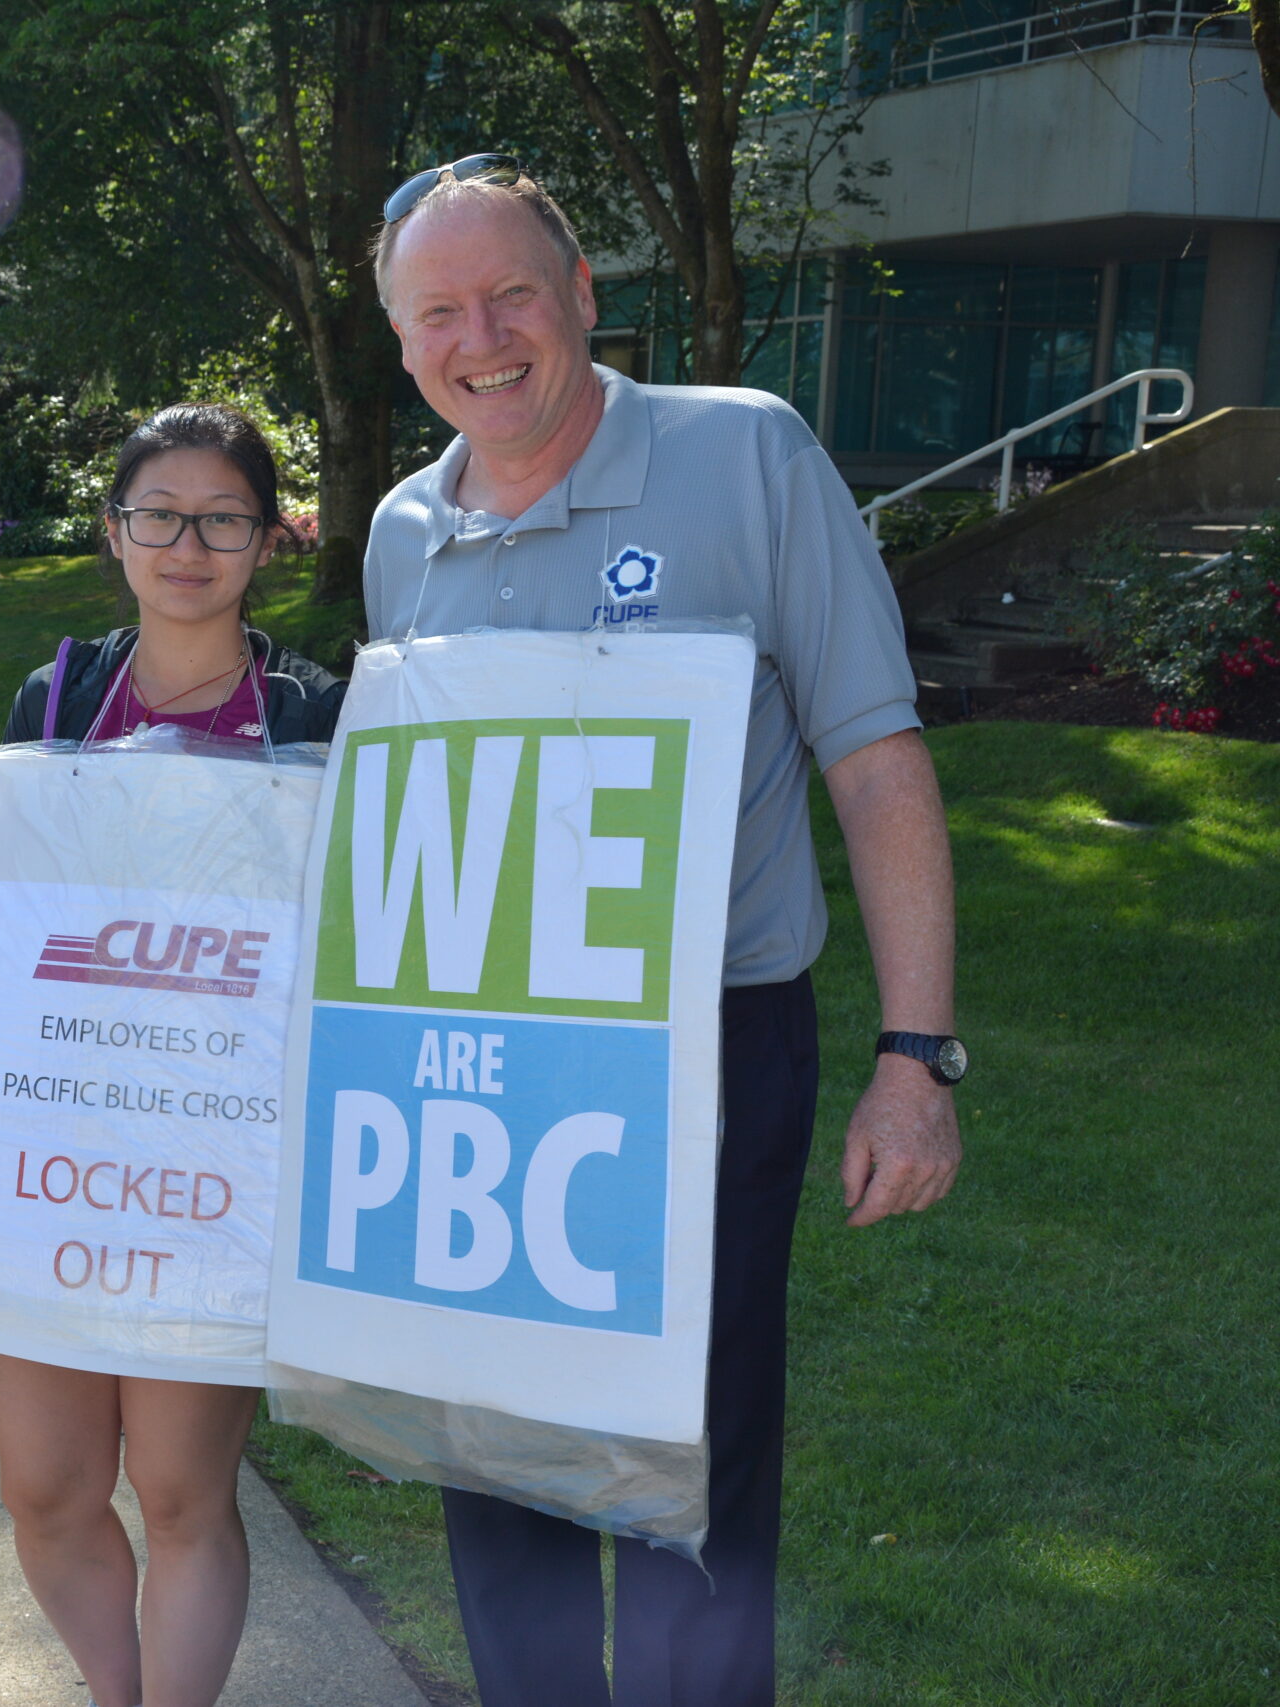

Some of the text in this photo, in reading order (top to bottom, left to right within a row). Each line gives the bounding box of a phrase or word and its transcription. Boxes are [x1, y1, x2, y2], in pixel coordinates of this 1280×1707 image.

[351, 735, 656, 1003] WE
[94, 920, 271, 979] CUPE
[195, 981, 224, 993] Local
[40, 1015, 245, 1058] EMPLOYEES OF
[413, 1029, 505, 1095] ARE
[3, 1072, 278, 1124] PACIFIC BLUE CROSS
[15, 1151, 234, 1222] LOCKED
[326, 1089, 626, 1312] PBC
[53, 1240, 175, 1300] OUT
